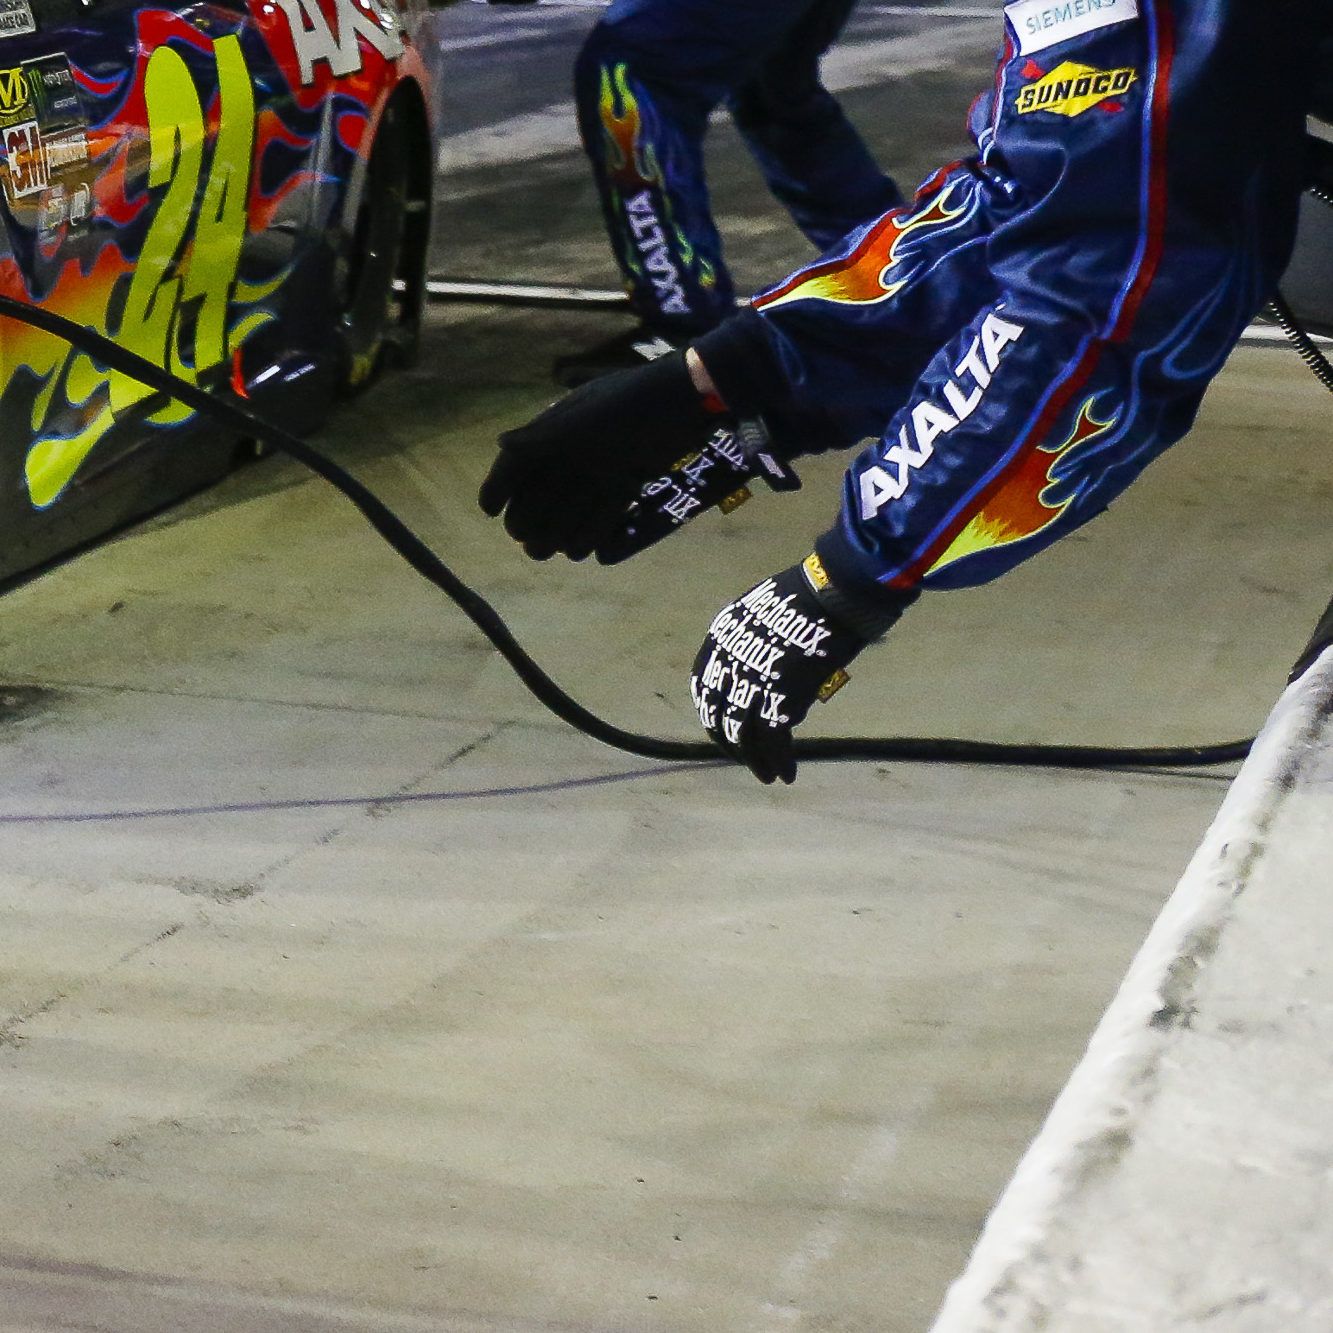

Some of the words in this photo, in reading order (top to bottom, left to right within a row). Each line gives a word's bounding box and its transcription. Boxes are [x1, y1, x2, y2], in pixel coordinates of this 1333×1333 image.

[1020, 70, 1132, 115] SUNOCO
[105, 33, 256, 418] 24
[625, 188, 691, 315] AXALTA
[857, 302, 1025, 521] AXALTA
[741, 577, 832, 657] Mechanix
